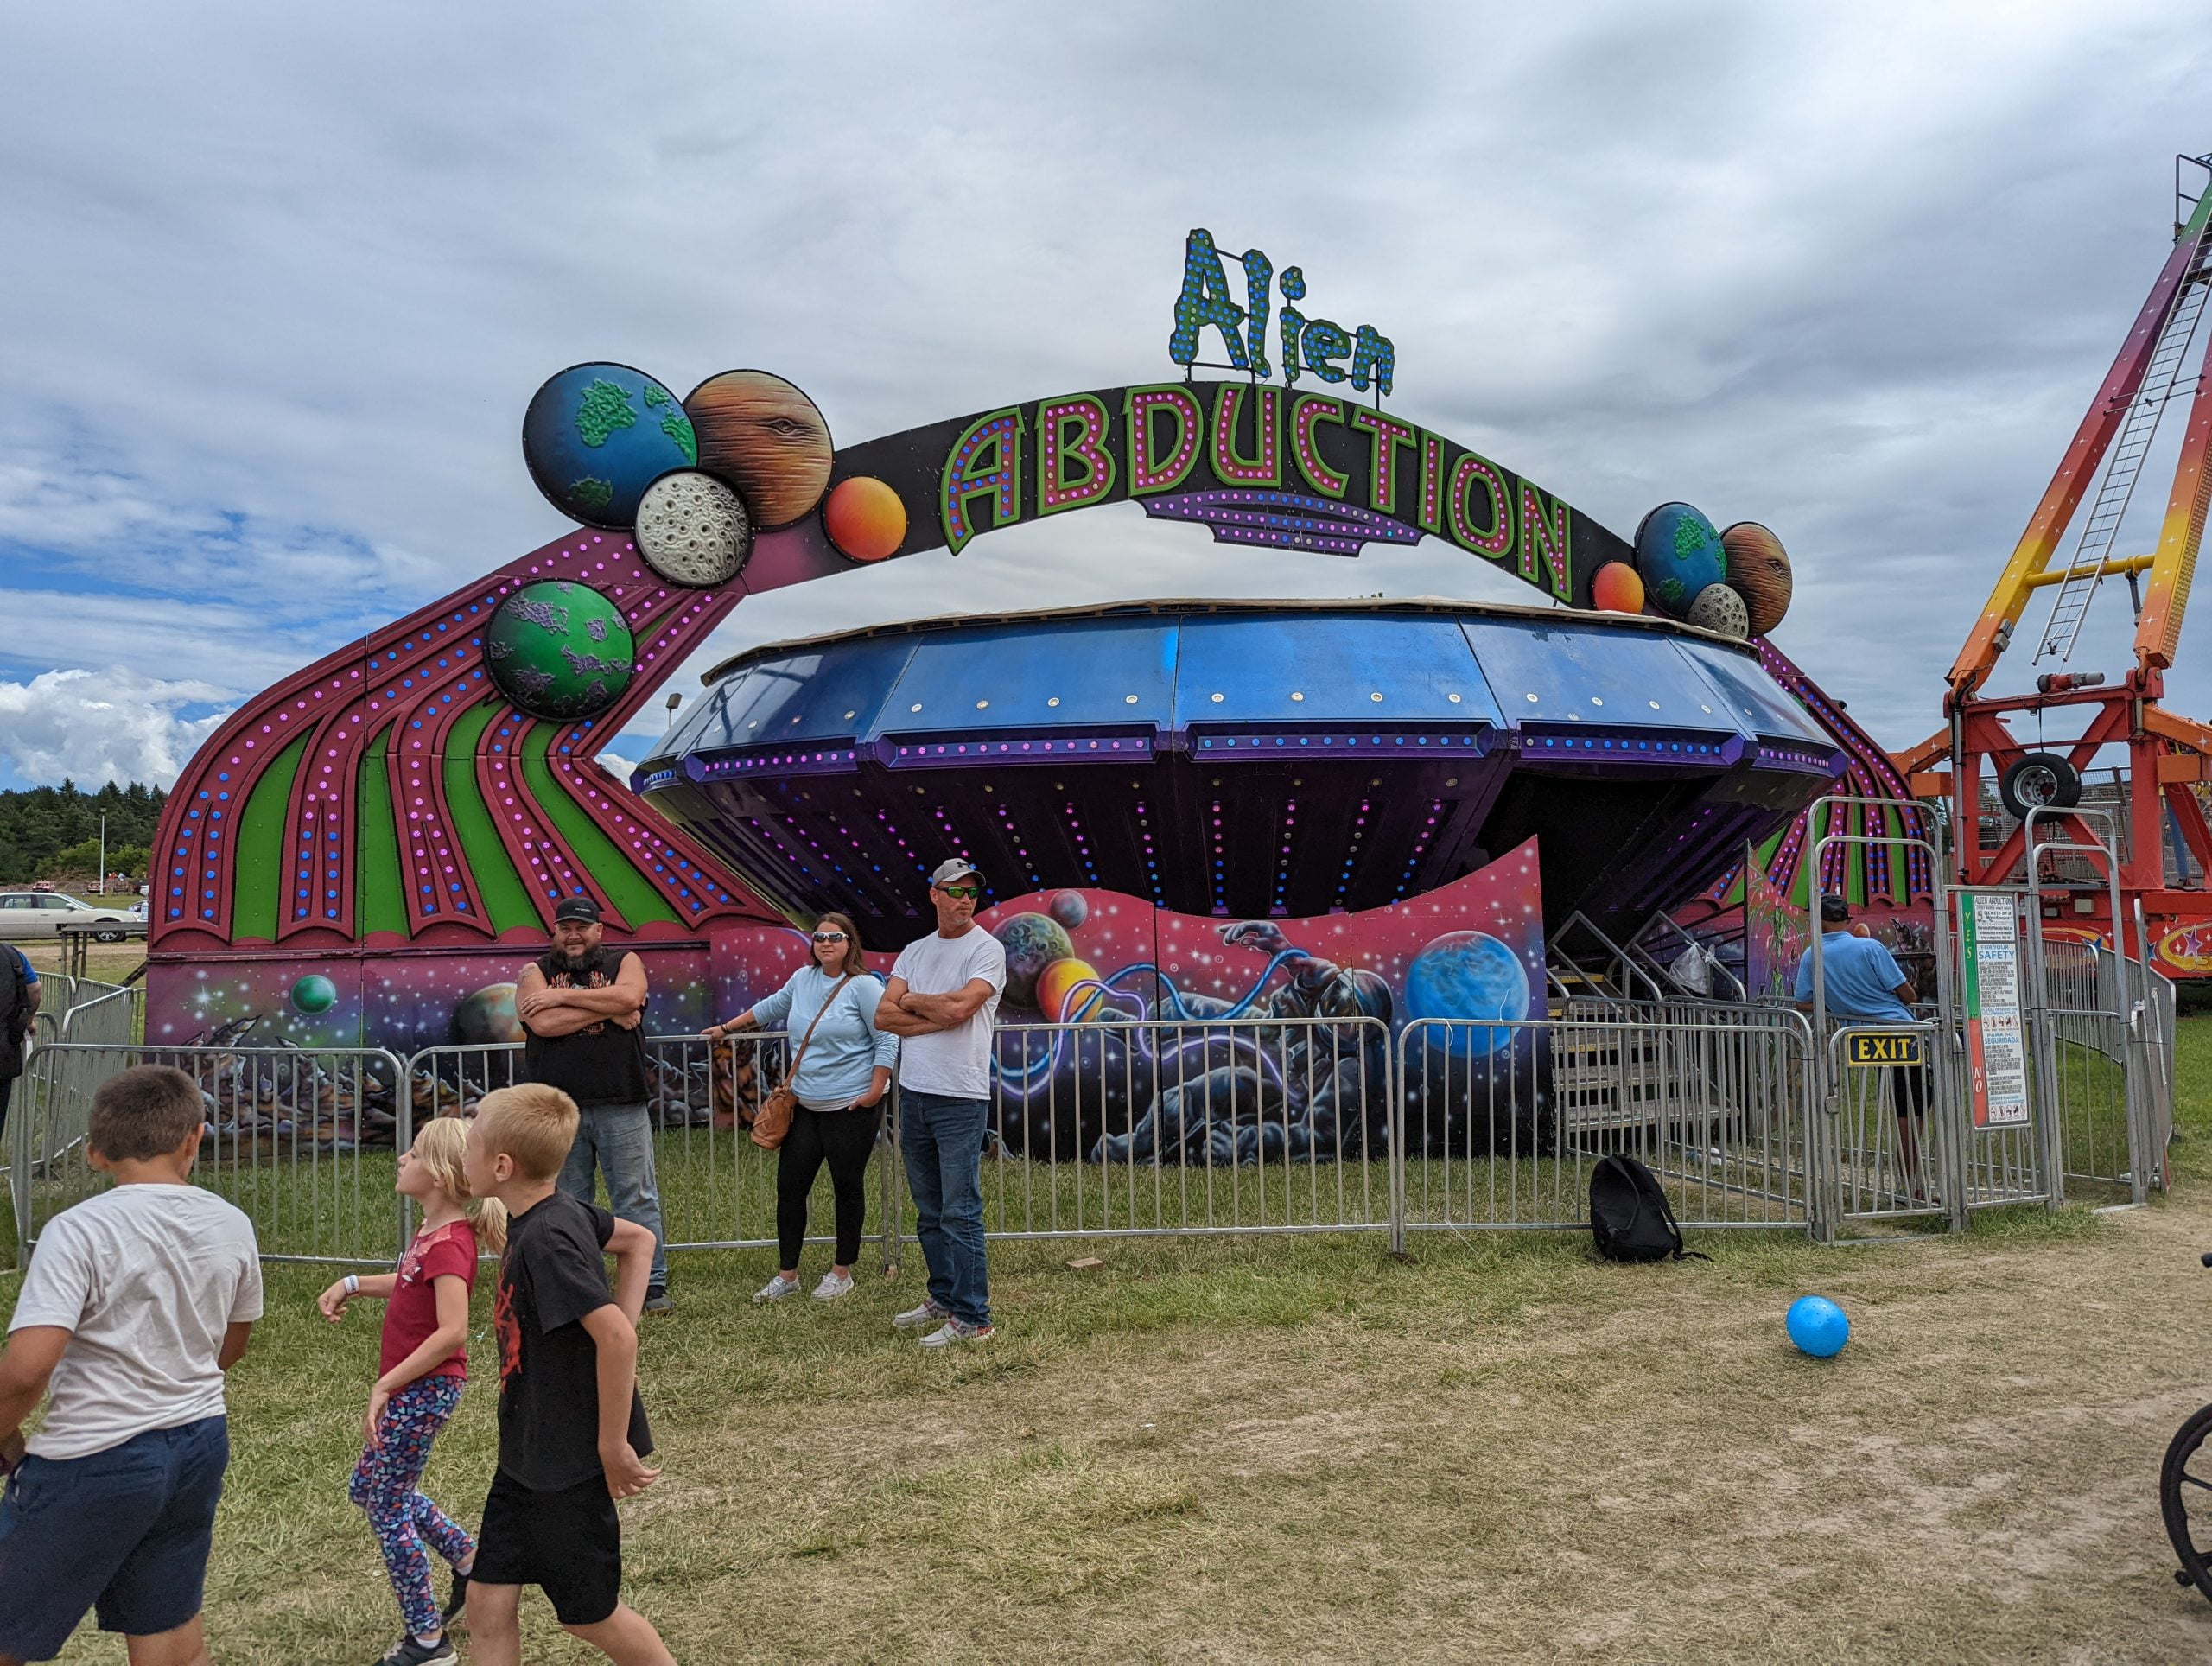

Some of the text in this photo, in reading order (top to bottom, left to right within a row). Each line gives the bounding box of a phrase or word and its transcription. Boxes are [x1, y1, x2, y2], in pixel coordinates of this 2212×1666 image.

[1169, 228, 1395, 396] Alien
[940, 383, 1572, 603] ABDUCTION
[1979, 951, 2015, 960] SAFETY
[1858, 1039, 1910, 1059] EXIT
[1974, 1066, 1983, 1093] NO
